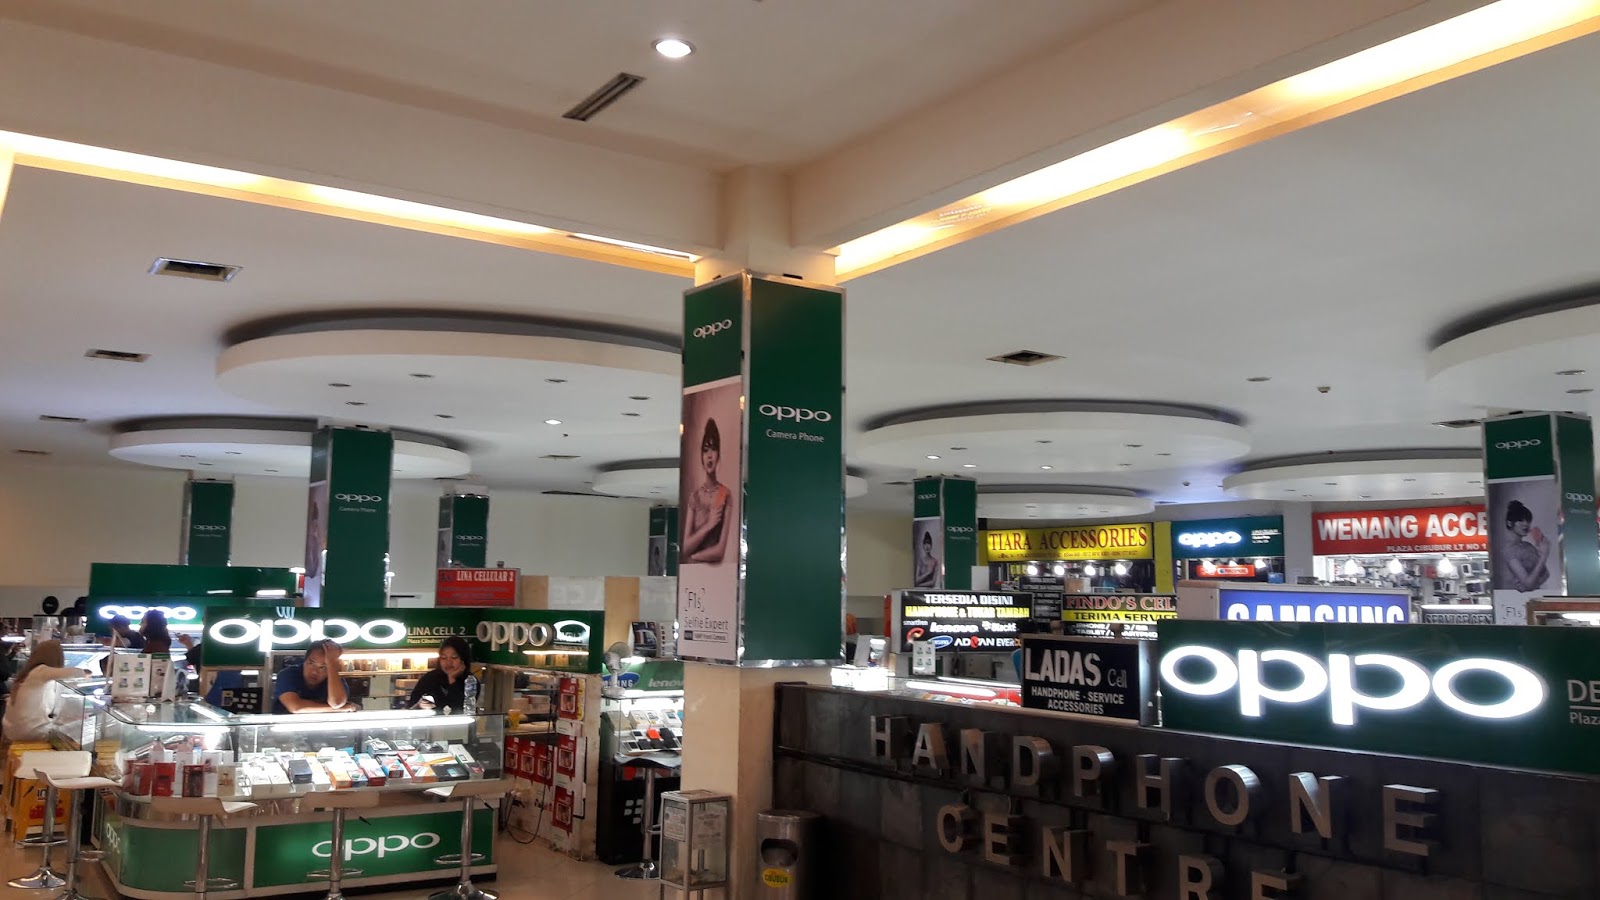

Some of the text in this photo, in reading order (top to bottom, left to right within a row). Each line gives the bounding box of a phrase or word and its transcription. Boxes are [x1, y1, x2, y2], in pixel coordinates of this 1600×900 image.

[693, 319, 733, 339] oppo
[759, 404, 832, 423] oppo
[766, 429, 825, 443] Camera Phone
[1495, 439, 1541, 450] oppo
[335, 493, 382, 503] oppo
[1565, 492, 1594, 502] oppo
[1317, 515, 1419, 541] WENANG
[990, 526, 1148, 551] TIARA ACCESSORIES
[1415, 544, 1453, 552] CIBUBUR
[456, 571, 473, 581] LINA
[474, 571, 509, 582] CELLULAR
[510, 571, 515, 582] 2
[924, 594, 1013, 605] TERSEDIA DISINI
[1065, 596, 1137, 610] FINDO'S
[1140, 597, 1178, 611] CEL
[684, 616, 728, 631] Selfie Expert
[1074, 612, 1119, 620] TERIMA
[407, 626, 466, 636] LINA CELL 2
[930, 622, 979, 632] lenovo
[210, 618, 407, 652] oppo
[476, 620, 553, 652] oppo
[1025, 648, 1128, 688] LADAS Cell
[1161, 645, 1546, 727] oppo
[1031, 686, 1080, 700] HANDPHONE
[1087, 691, 1125, 705] SERVICE
[1047, 700, 1105, 715] ACCESSORIES
[1570, 712, 1600, 725] Plaz
[870, 715, 1434, 857] HANDPHONE
[312, 832, 441, 861] oppo
